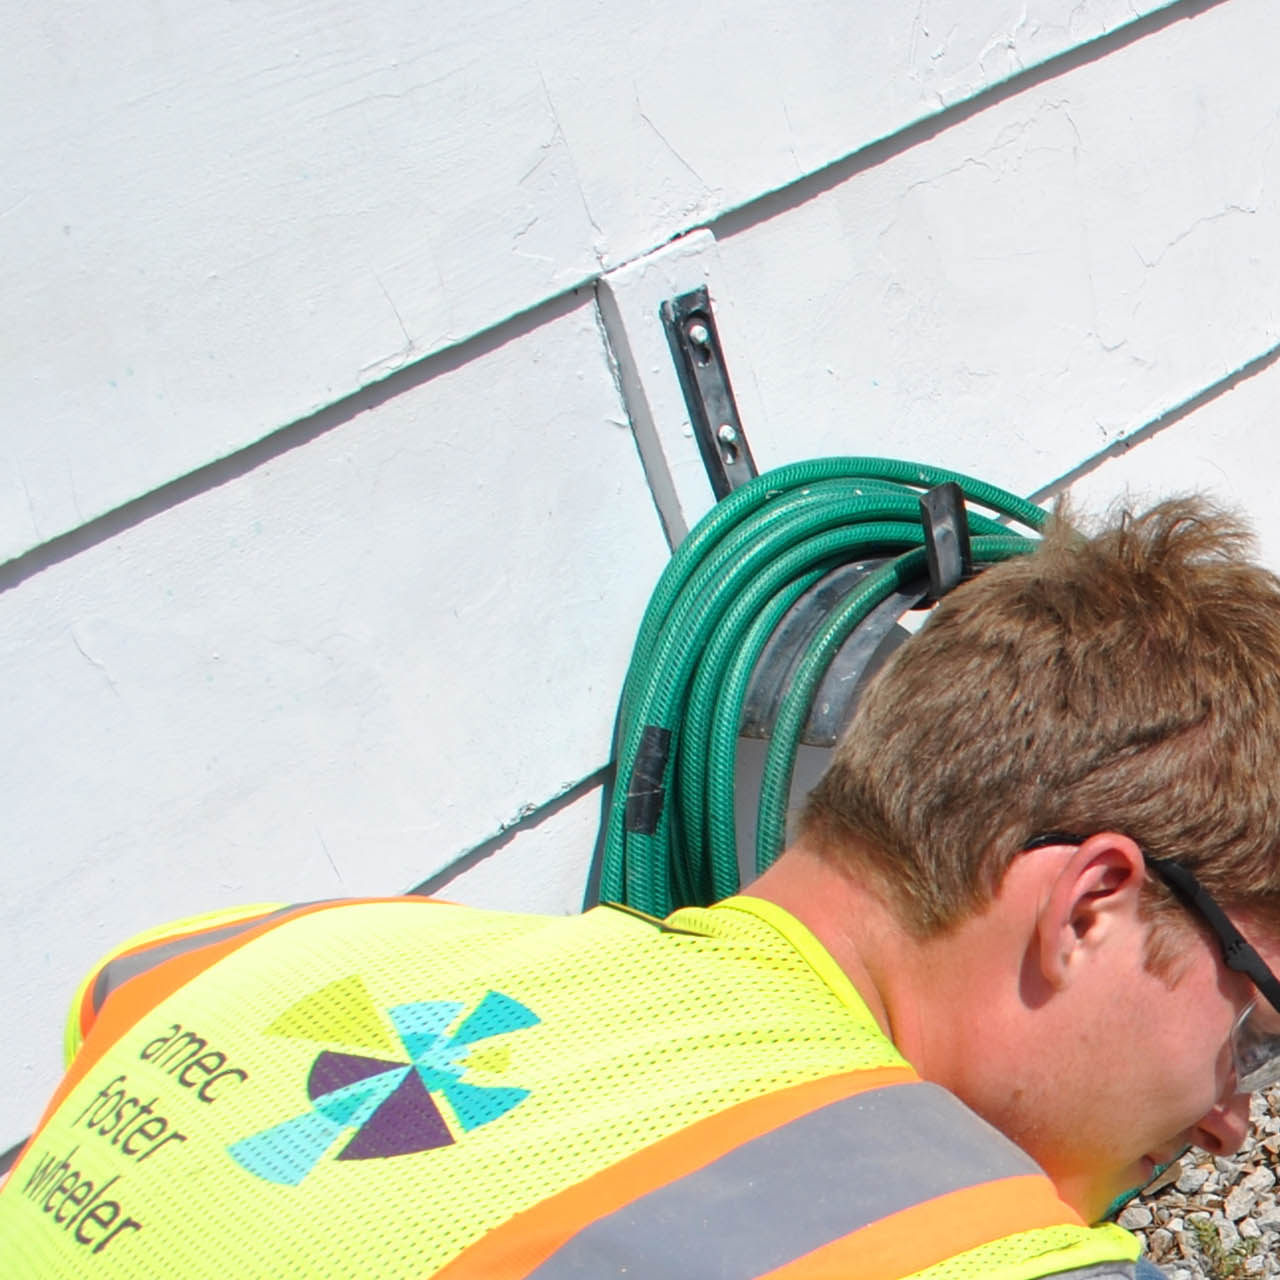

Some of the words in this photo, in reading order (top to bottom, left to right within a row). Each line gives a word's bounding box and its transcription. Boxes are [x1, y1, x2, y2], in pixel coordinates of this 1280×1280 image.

[140, 1024, 248, 1103] amec
[71, 1075, 187, 1163] foster
[22, 1145, 142, 1254] wheeler
